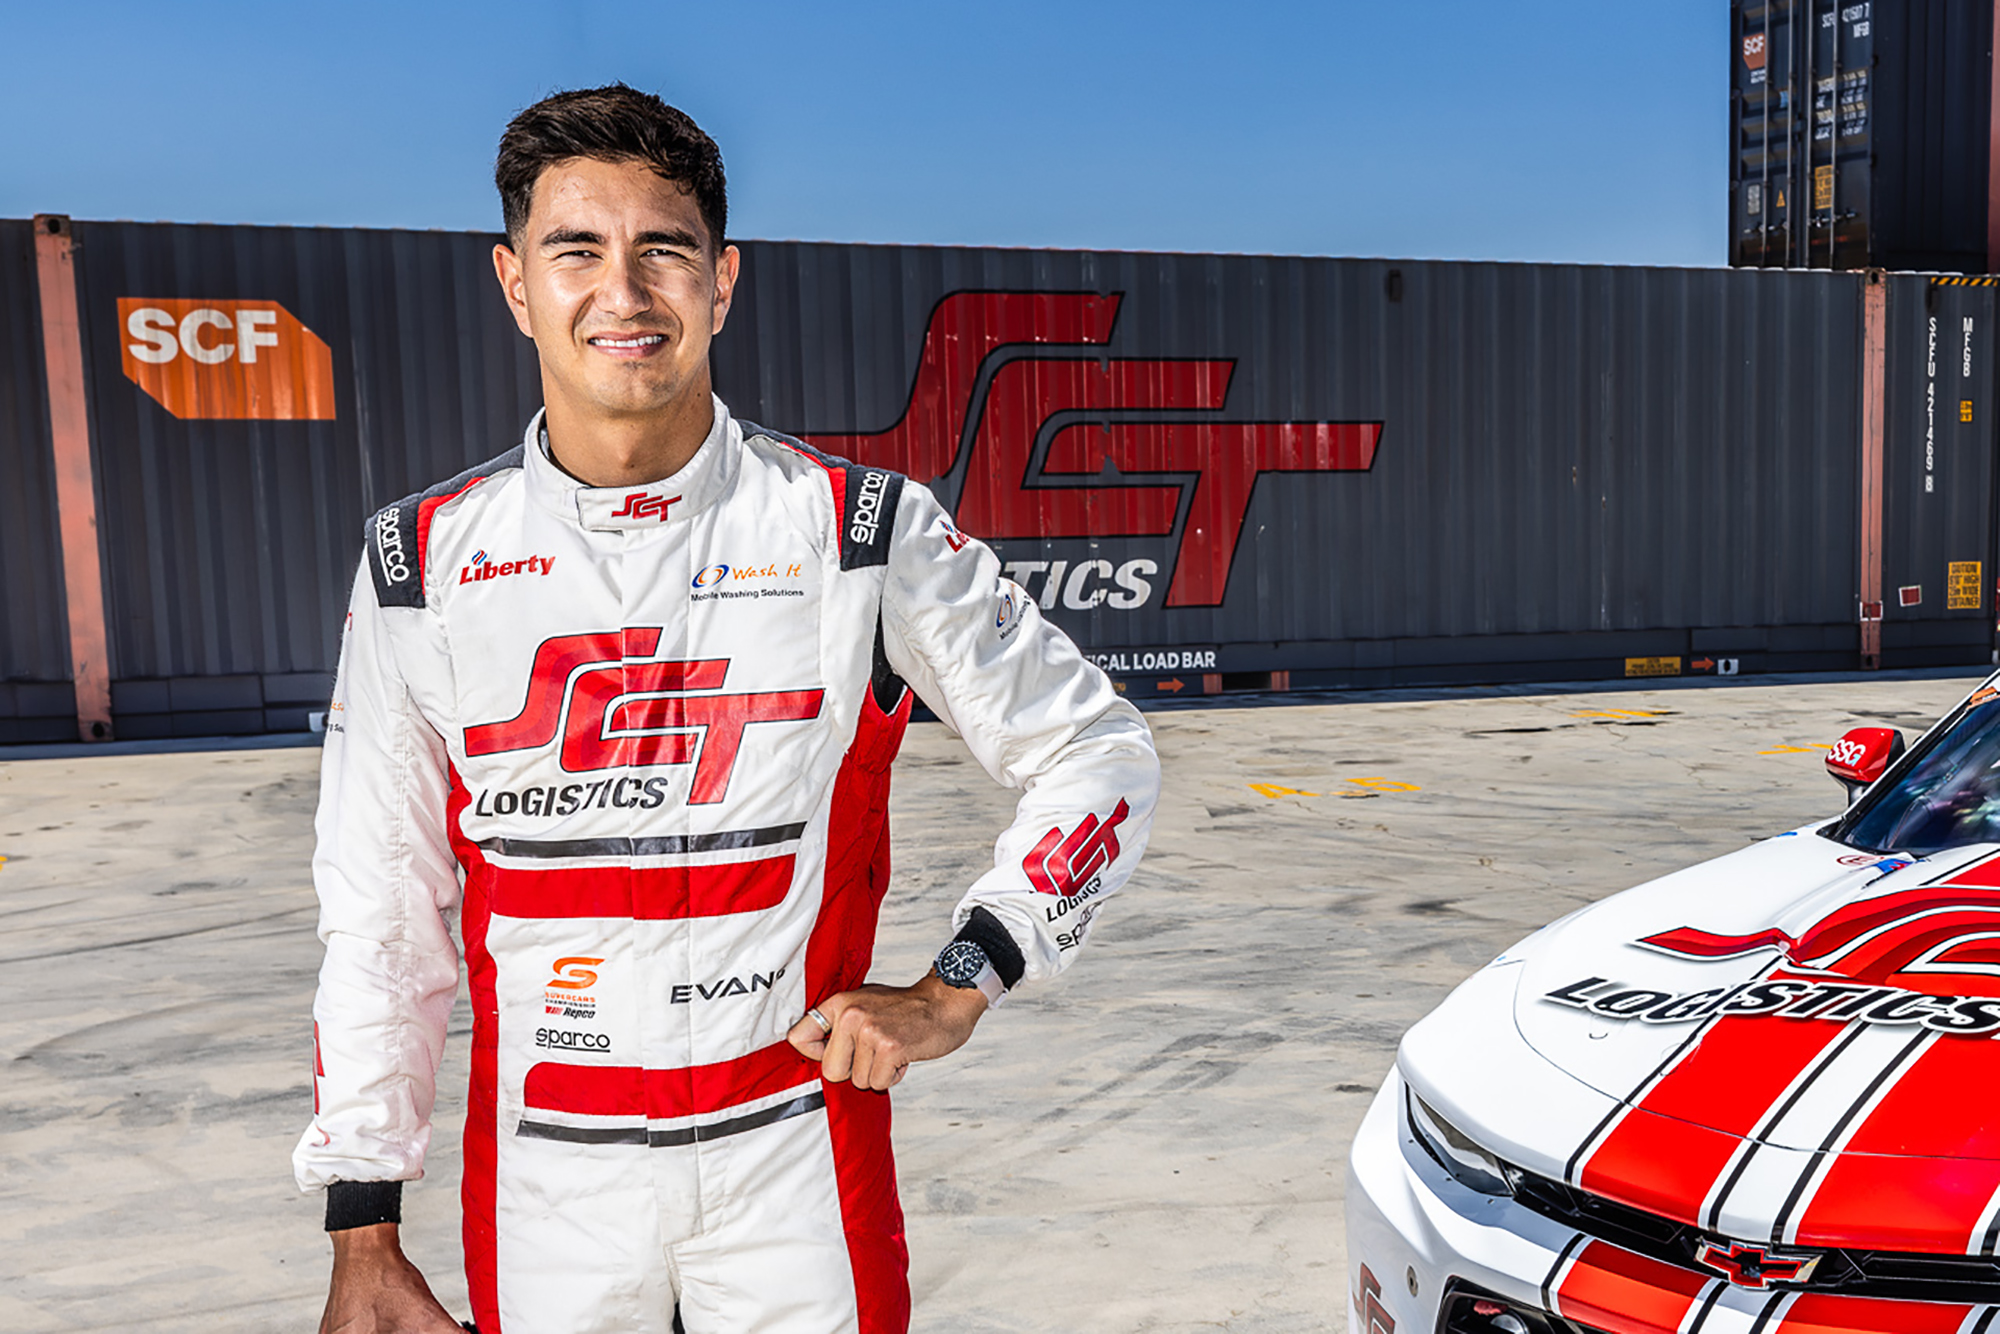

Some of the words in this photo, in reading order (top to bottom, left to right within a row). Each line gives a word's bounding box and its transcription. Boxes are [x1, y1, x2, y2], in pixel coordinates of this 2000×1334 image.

[1743, 35, 1765, 56] SCF
[127, 308, 278, 364] SCF
[1928, 317, 1937, 377] SCFU
[1962, 317, 1973, 377] MFGB
[611, 492, 682, 522] SCT
[850, 472, 890, 546] sparco
[375, 507, 410, 587] sparco
[459, 550, 556, 586] Liberty
[732, 563, 778, 580] Wash
[691, 592, 719, 602] Mobile
[721, 590, 759, 600] Washing
[761, 588, 804, 597] Solutions
[1133, 652, 1179, 670] LOAD
[1182, 651, 1216, 669] BAR
[463, 625, 826, 806] SCT
[1827, 738, 1867, 767] SSG
[475, 776, 669, 818] LOGISTICS
[545, 991, 596, 1003] SUPERCARS
[563, 1006, 596, 1020] Repco
[1543, 976, 2000, 1034] LOGISTICS
[535, 1027, 611, 1053] sparco
